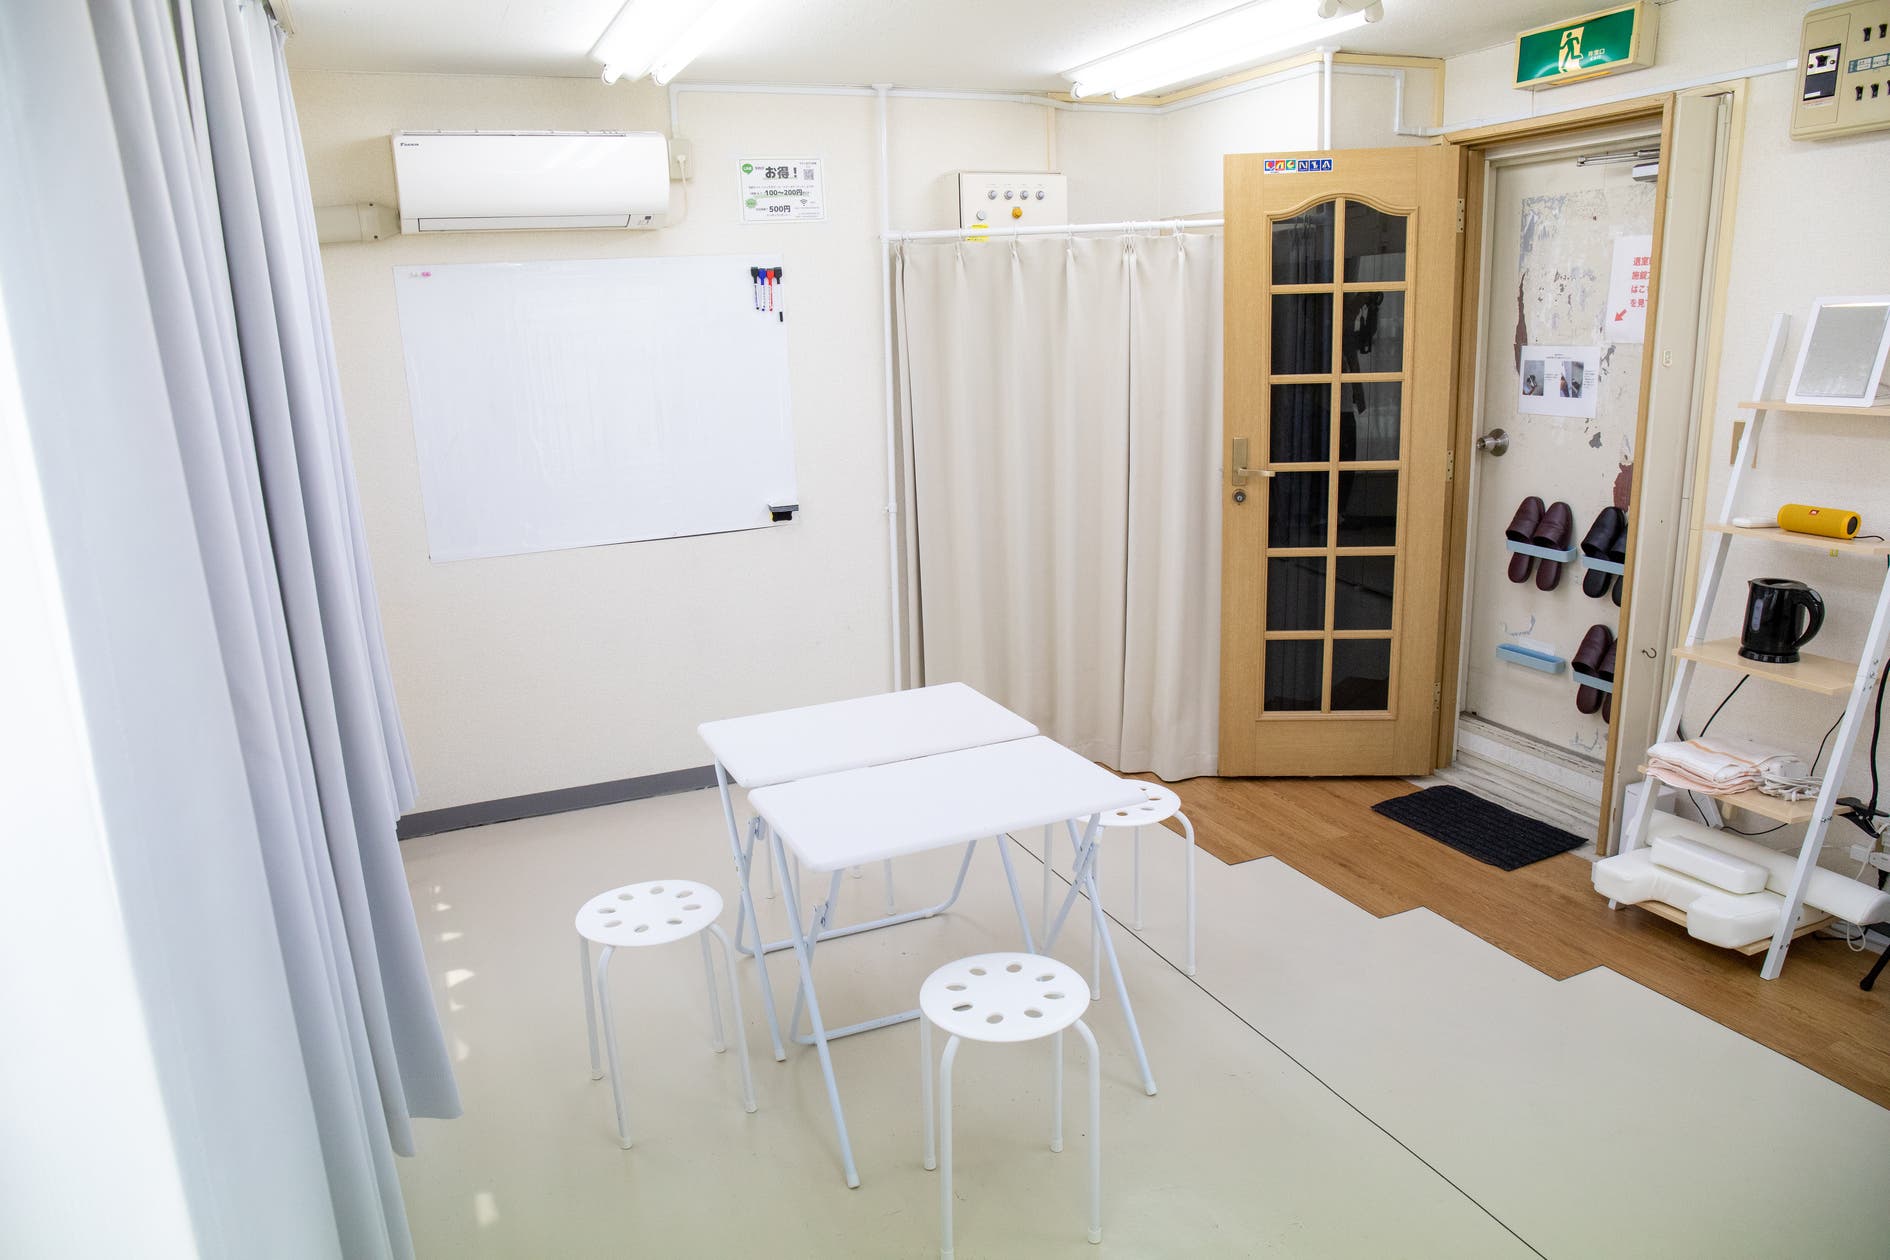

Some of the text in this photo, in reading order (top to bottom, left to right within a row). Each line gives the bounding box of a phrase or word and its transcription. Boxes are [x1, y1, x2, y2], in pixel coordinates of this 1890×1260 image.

[769, 205, 791, 213] 500円
[1633, 256, 1651, 266] 退室
[1631, 285, 1648, 294] はこ
